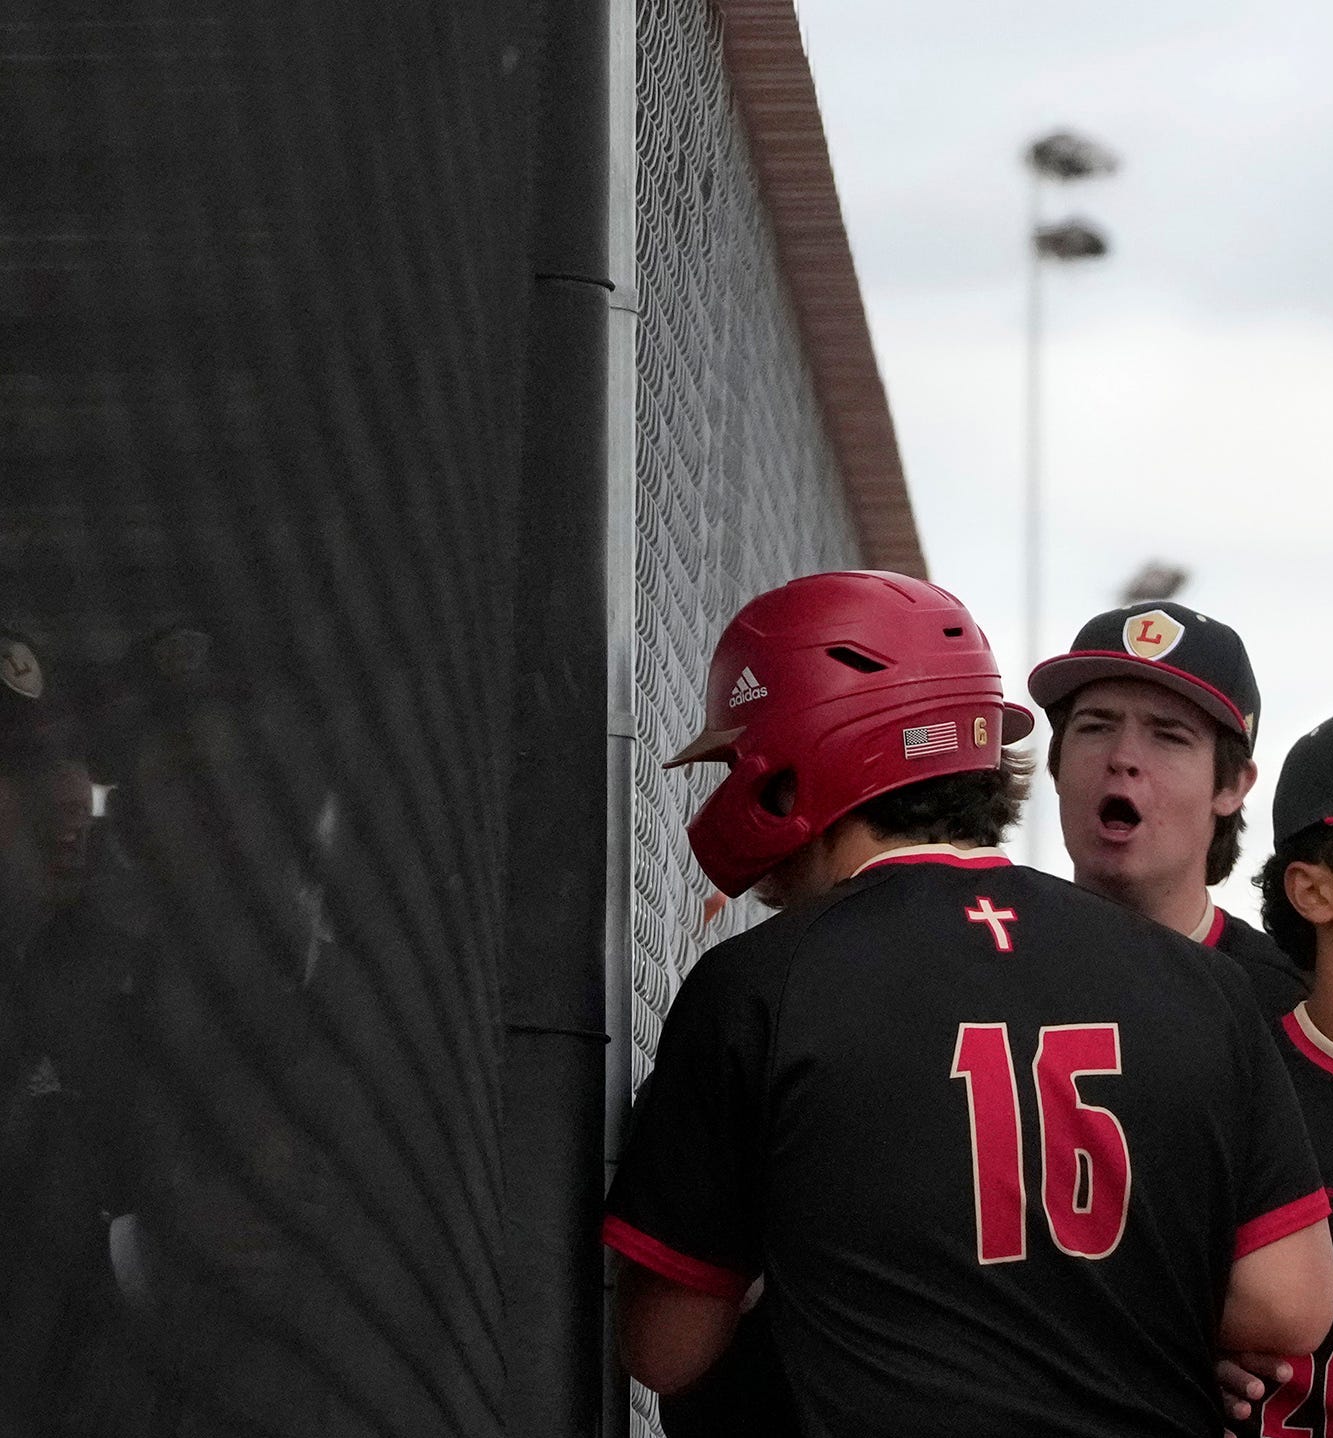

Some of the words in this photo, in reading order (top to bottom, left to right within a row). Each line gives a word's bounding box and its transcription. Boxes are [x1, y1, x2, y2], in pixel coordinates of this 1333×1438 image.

[1135, 618, 1162, 645] L
[729, 686, 768, 708] adidas
[973, 717, 987, 748] 6
[950, 1022, 1131, 1265] 16
